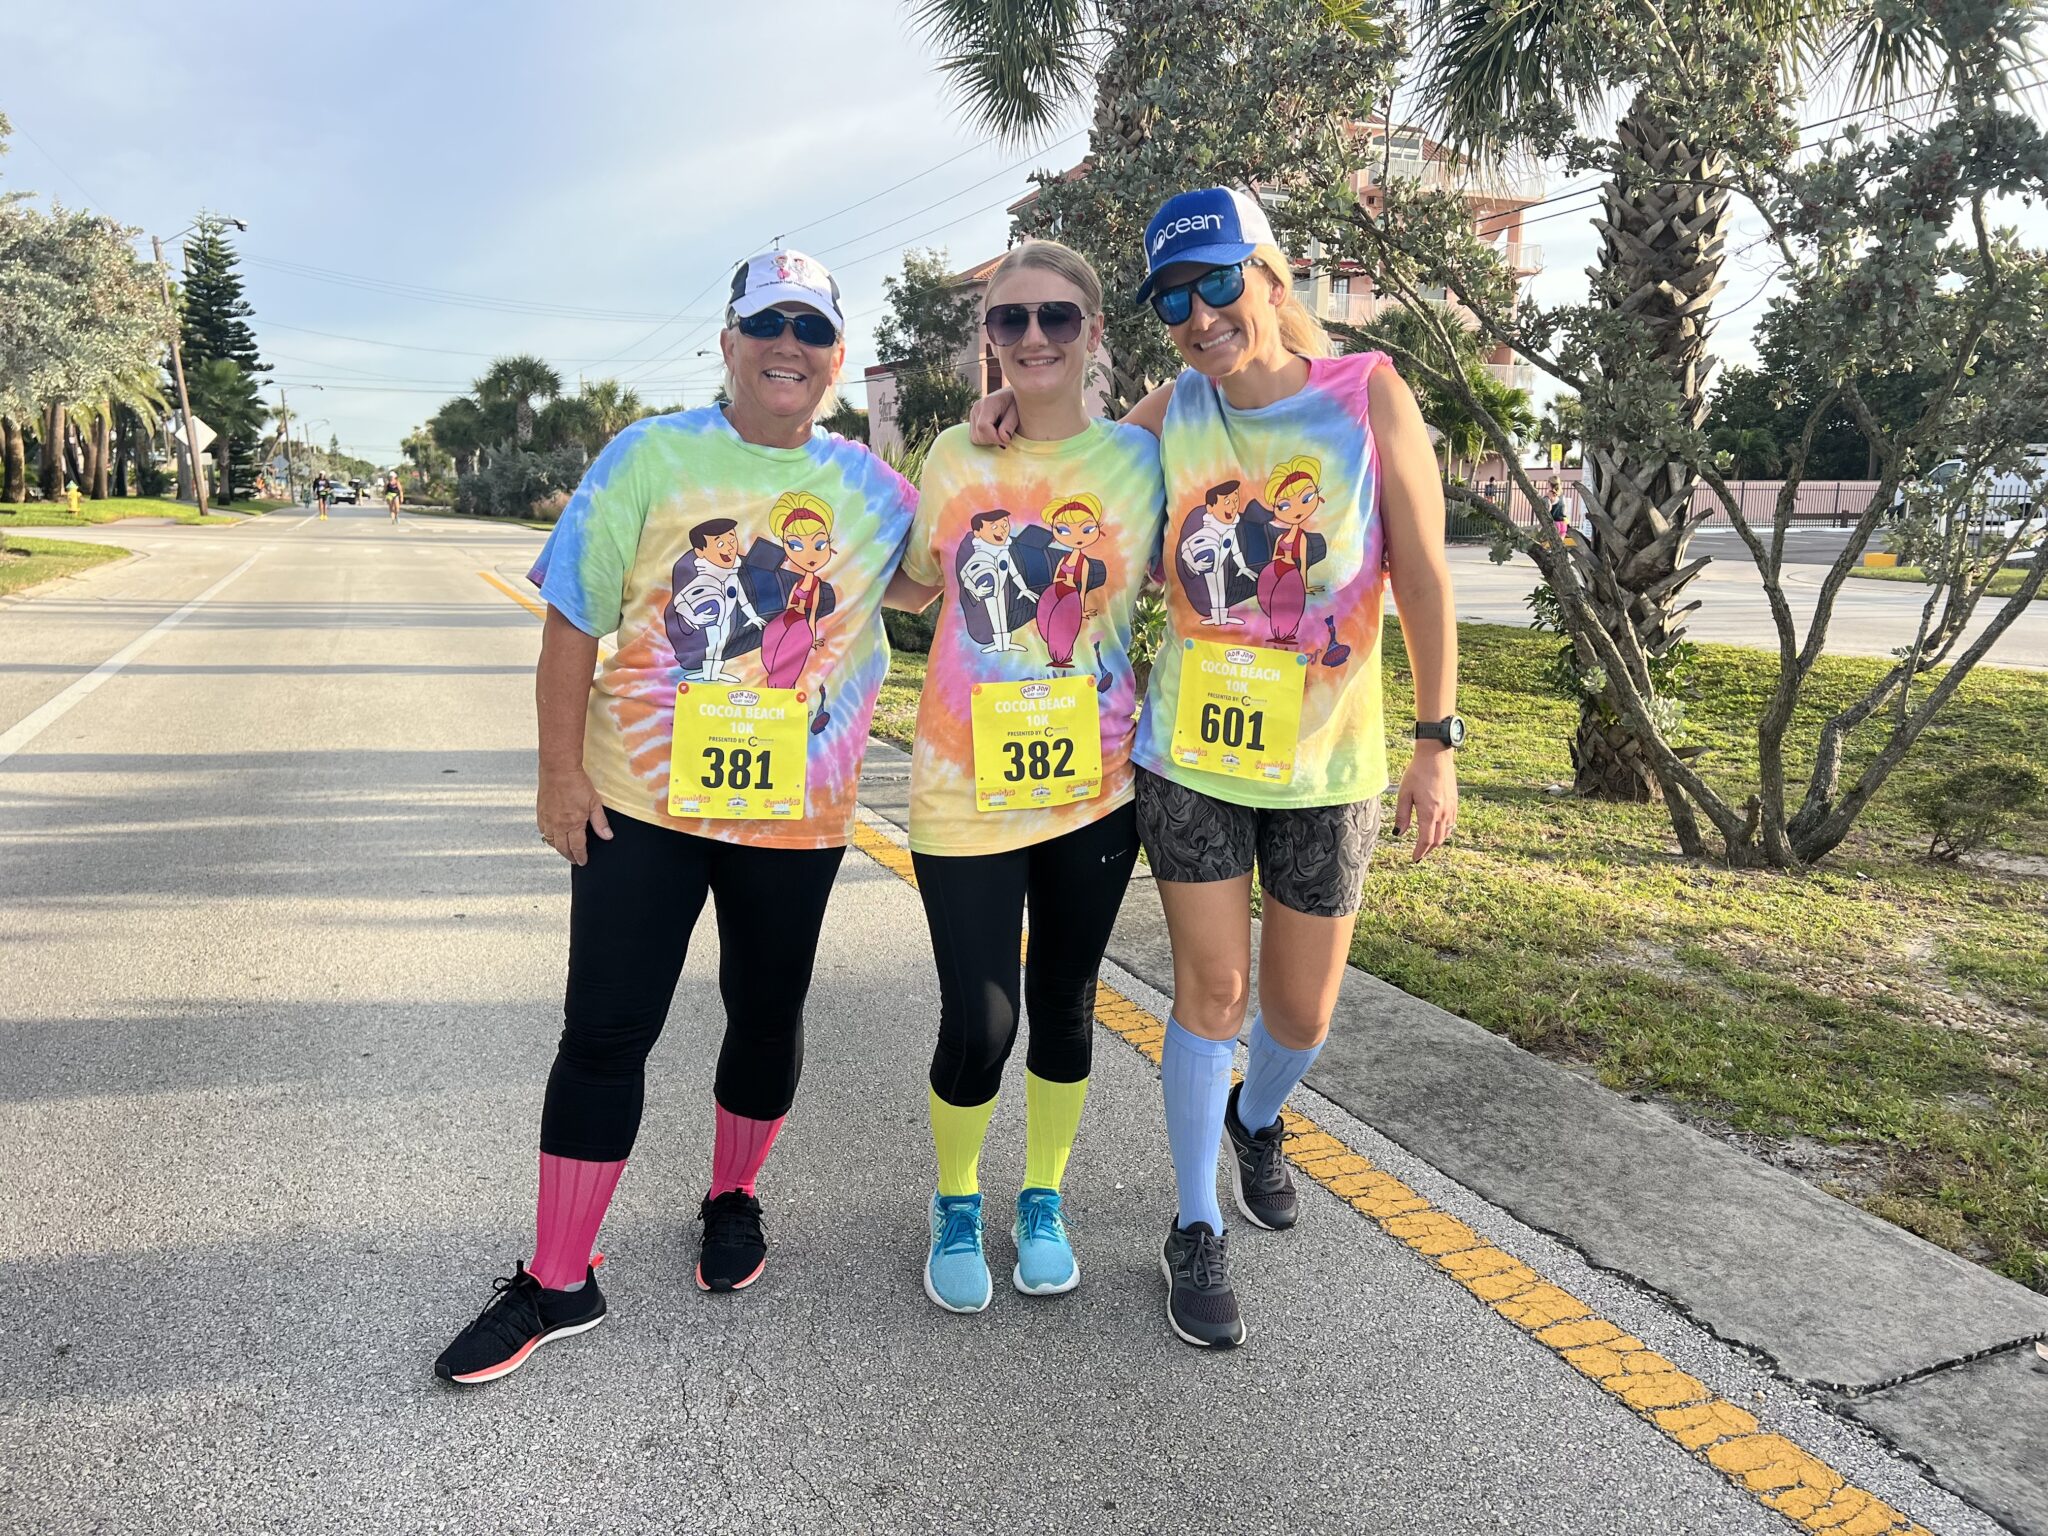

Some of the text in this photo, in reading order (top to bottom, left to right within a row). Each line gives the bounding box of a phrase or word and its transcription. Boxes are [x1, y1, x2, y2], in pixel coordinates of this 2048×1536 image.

[1201, 660, 1281, 681] COCOA BEACH
[1225, 679, 1249, 694] 10K
[995, 696, 1076, 714] COCOA BEACH
[1208, 692, 1231, 701] PRESENTED
[699, 703, 785, 720] COCOA BEACH
[730, 721, 755, 734] 10K
[1026, 715, 1049, 727] 10K
[1200, 703, 1265, 751] 601
[701, 747, 773, 790] 381
[1002, 738, 1075, 782] 382
